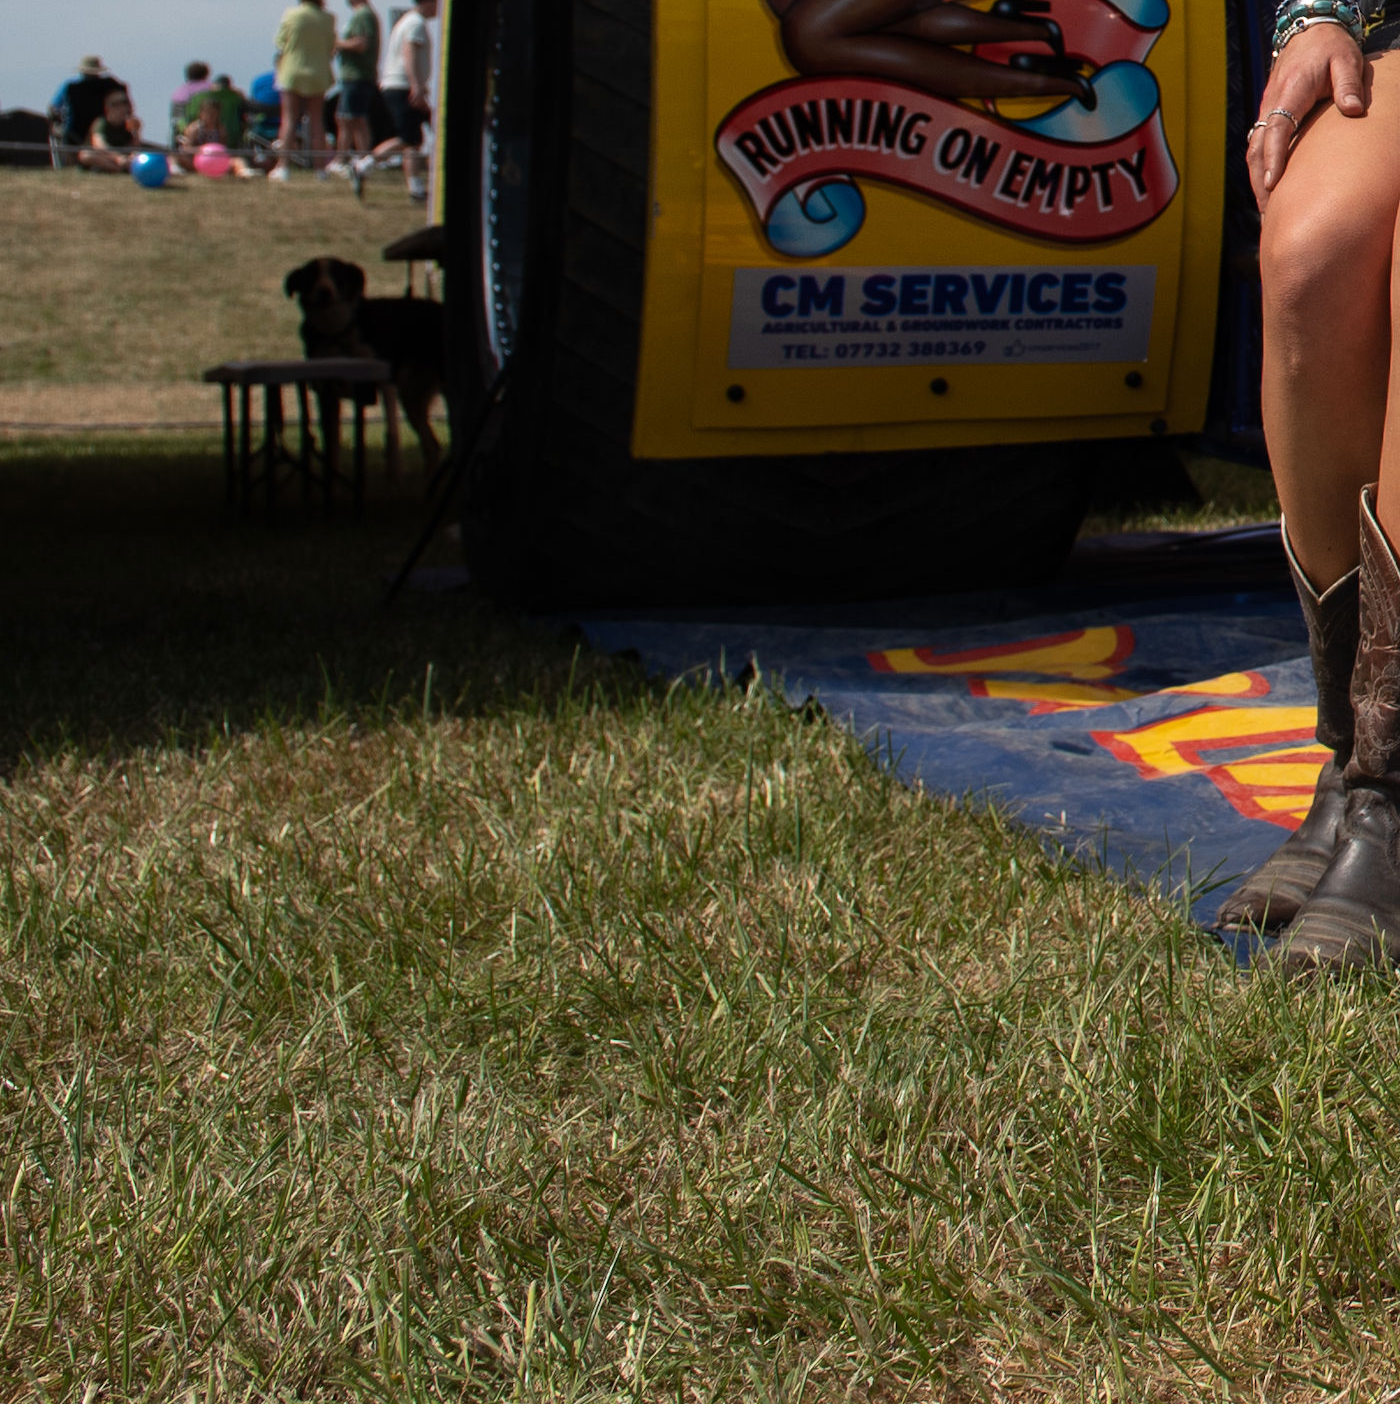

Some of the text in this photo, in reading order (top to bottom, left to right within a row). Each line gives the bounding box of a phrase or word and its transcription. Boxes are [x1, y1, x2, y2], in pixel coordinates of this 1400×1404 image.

[734, 98, 1148, 216] RUNNING ON EMPTY
[761, 273, 1127, 318] CM SERVICES
[761, 317, 1124, 334] AGRICULTURAL & GROUNDWORK CONTRACTORS
[783, 344, 829, 360] TEL:
[835, 343, 901, 358] 07732
[908, 340, 987, 357] 388369
